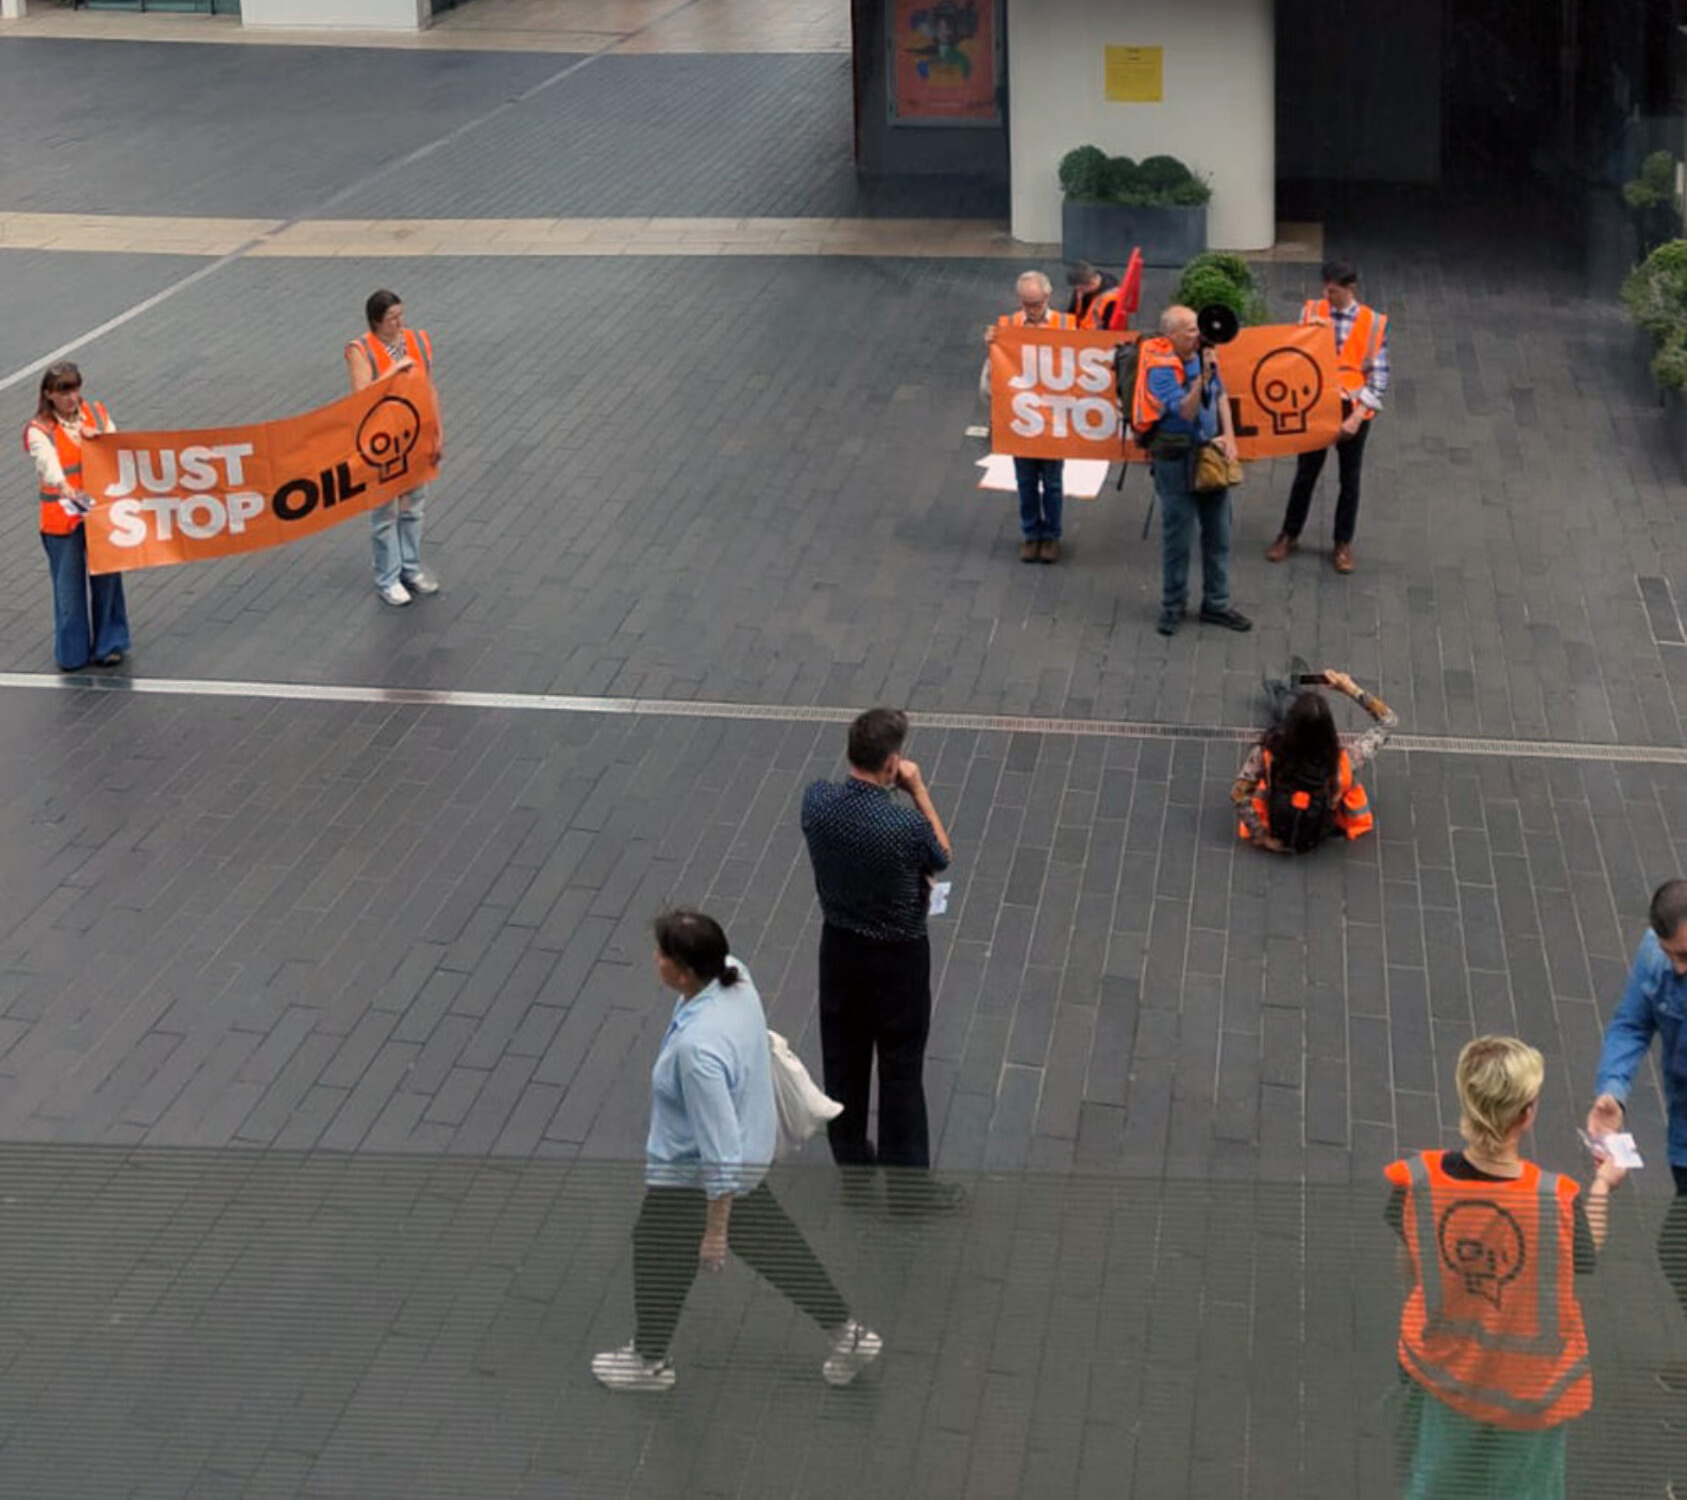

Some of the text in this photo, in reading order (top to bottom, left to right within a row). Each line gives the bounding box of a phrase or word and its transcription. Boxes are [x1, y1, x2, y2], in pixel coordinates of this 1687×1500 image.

[1007, 344, 1116, 393] JUS
[1009, 391, 1132, 441] STO
[103, 442, 254, 498] JUST
[107, 460, 367, 548] STOP OIL
